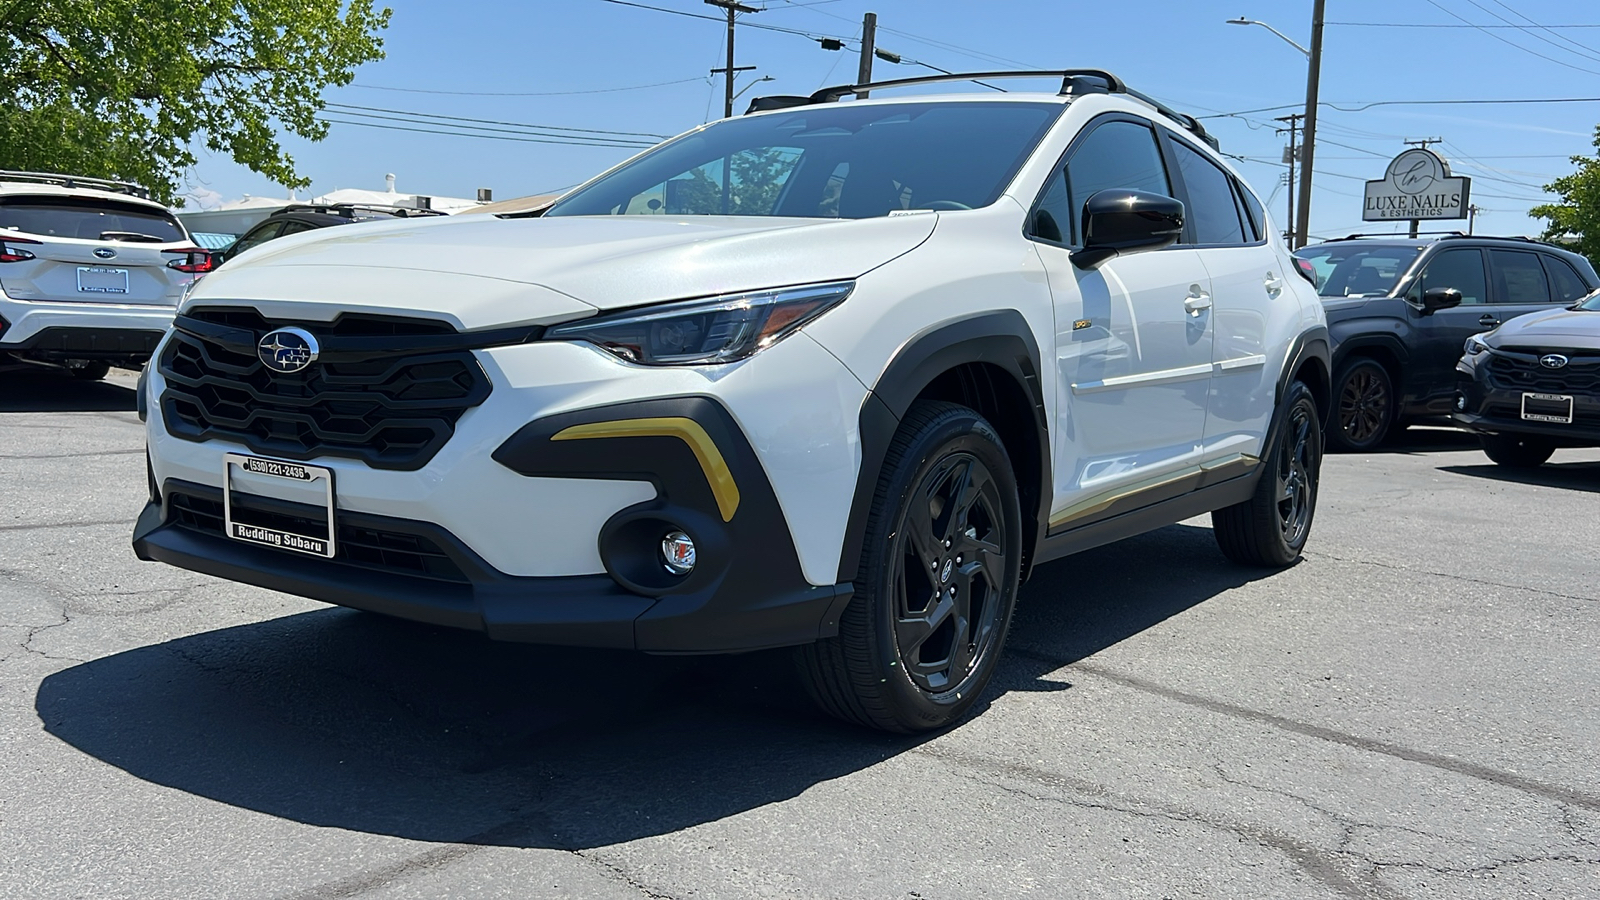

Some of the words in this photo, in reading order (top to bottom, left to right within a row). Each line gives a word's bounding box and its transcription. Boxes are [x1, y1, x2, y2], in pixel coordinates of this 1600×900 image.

[1366, 195, 1407, 211] LUXE
[1410, 193, 1460, 209] NAILS
[1389, 208, 1443, 217] ESTHETICS
[238, 525, 281, 545] Redding
[283, 534, 322, 552] Subaru
